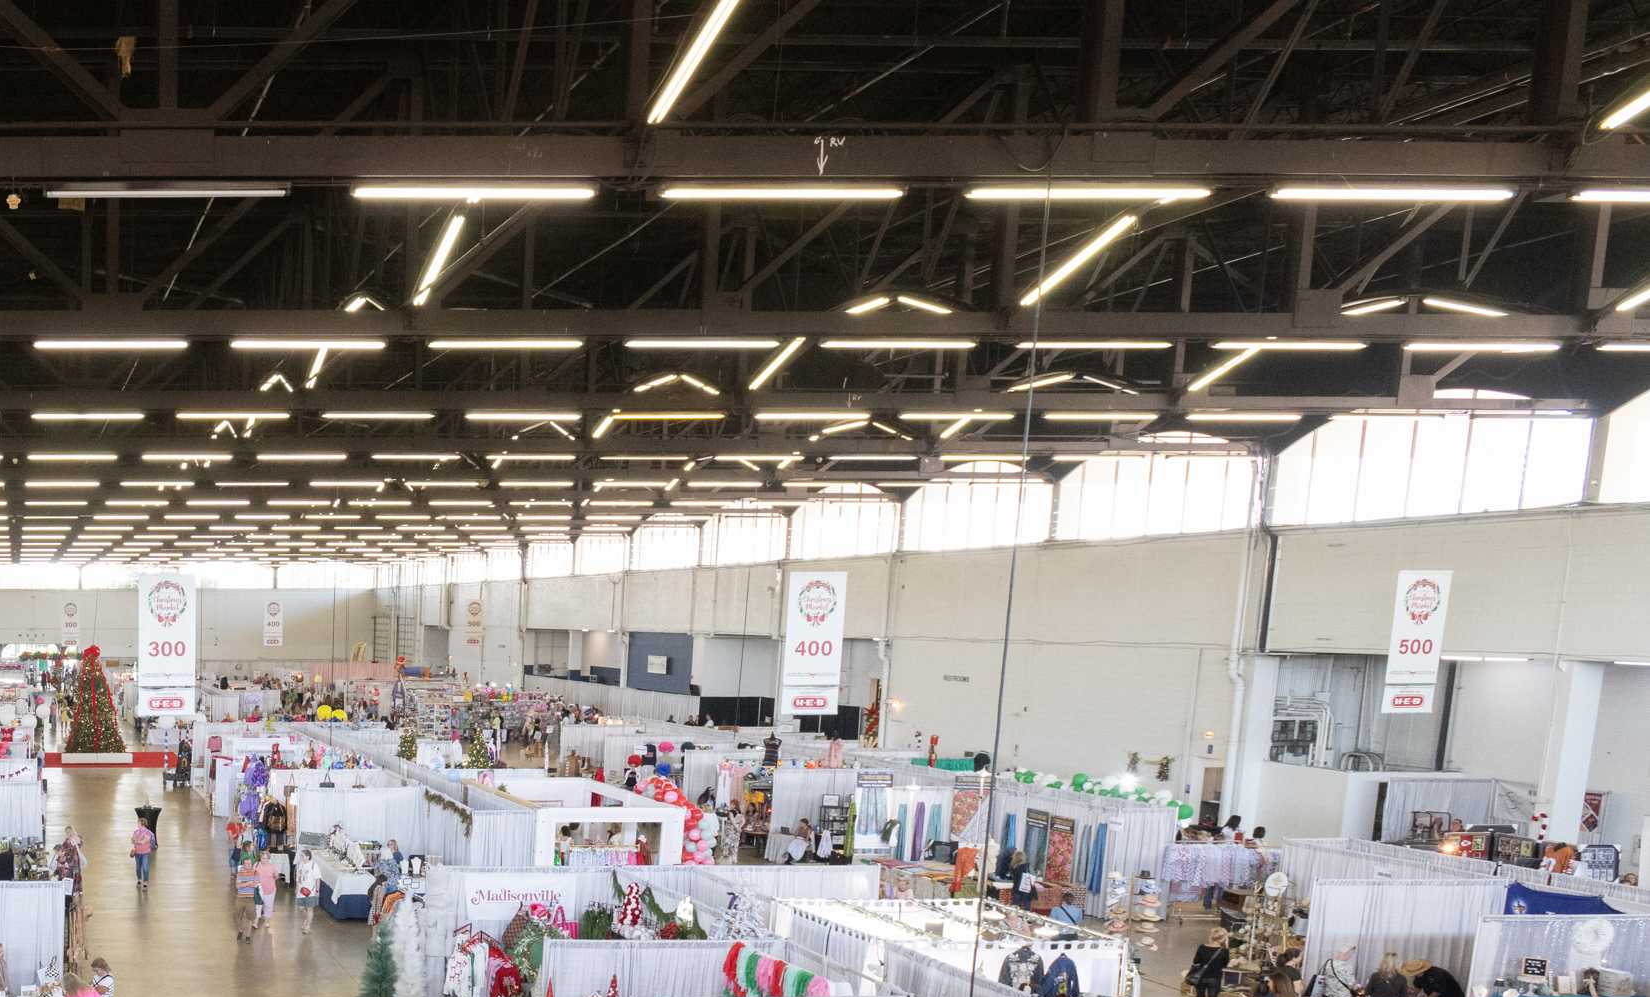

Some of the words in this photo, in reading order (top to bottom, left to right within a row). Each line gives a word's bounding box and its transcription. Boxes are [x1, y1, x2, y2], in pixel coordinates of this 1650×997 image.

[149, 640, 186, 657] 300
[794, 640, 833, 656] 400
[1398, 639, 1433, 655] 500
[471, 888, 562, 905] Madisonville
